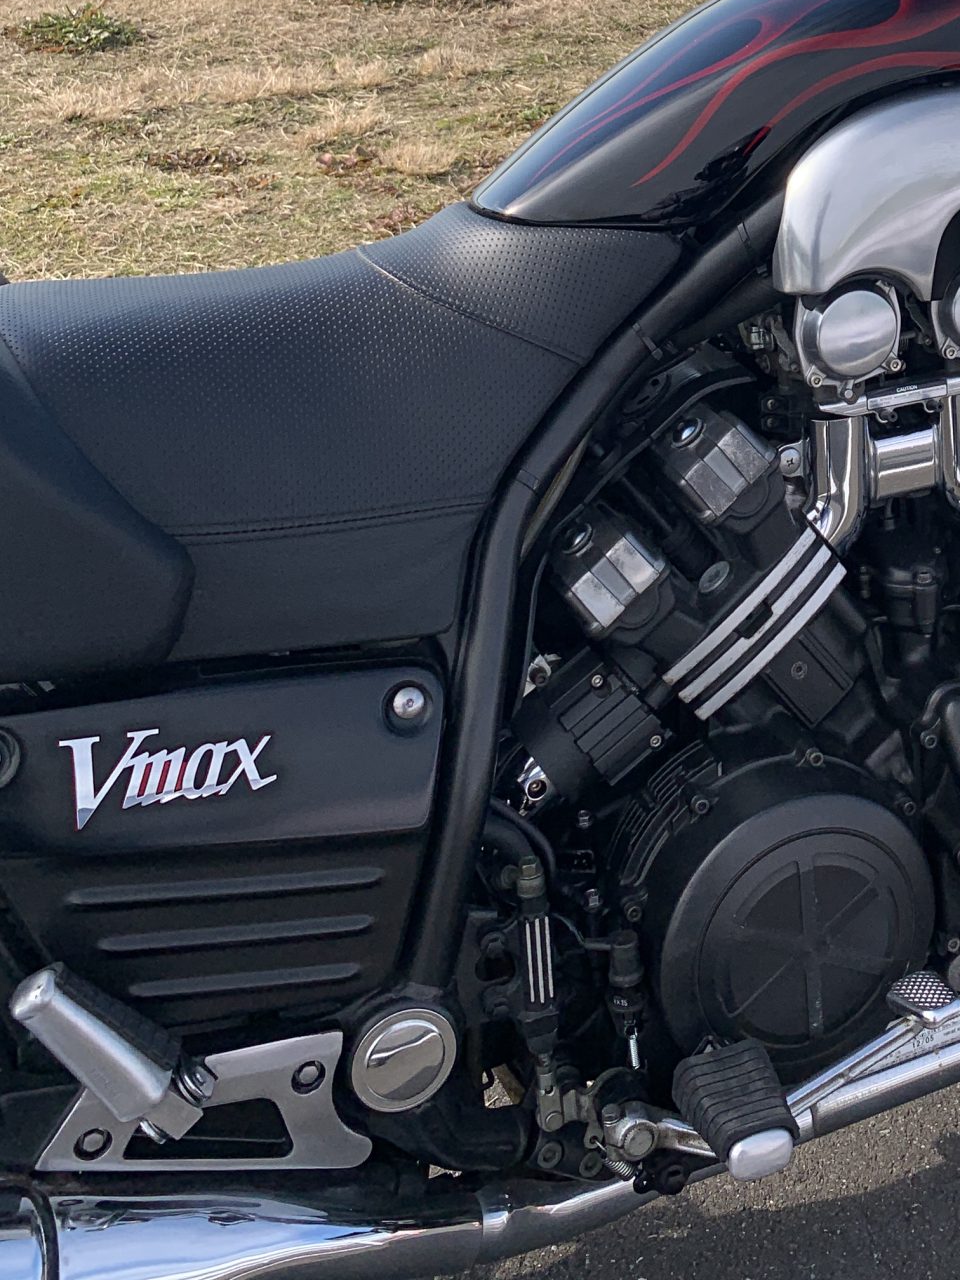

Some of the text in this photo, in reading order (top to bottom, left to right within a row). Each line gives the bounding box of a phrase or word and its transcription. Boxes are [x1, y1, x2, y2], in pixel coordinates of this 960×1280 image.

[896, 385, 918, 393] CAUTION
[58, 728, 277, 830] Vmax
[912, 1034, 934, 1049] 12/05
